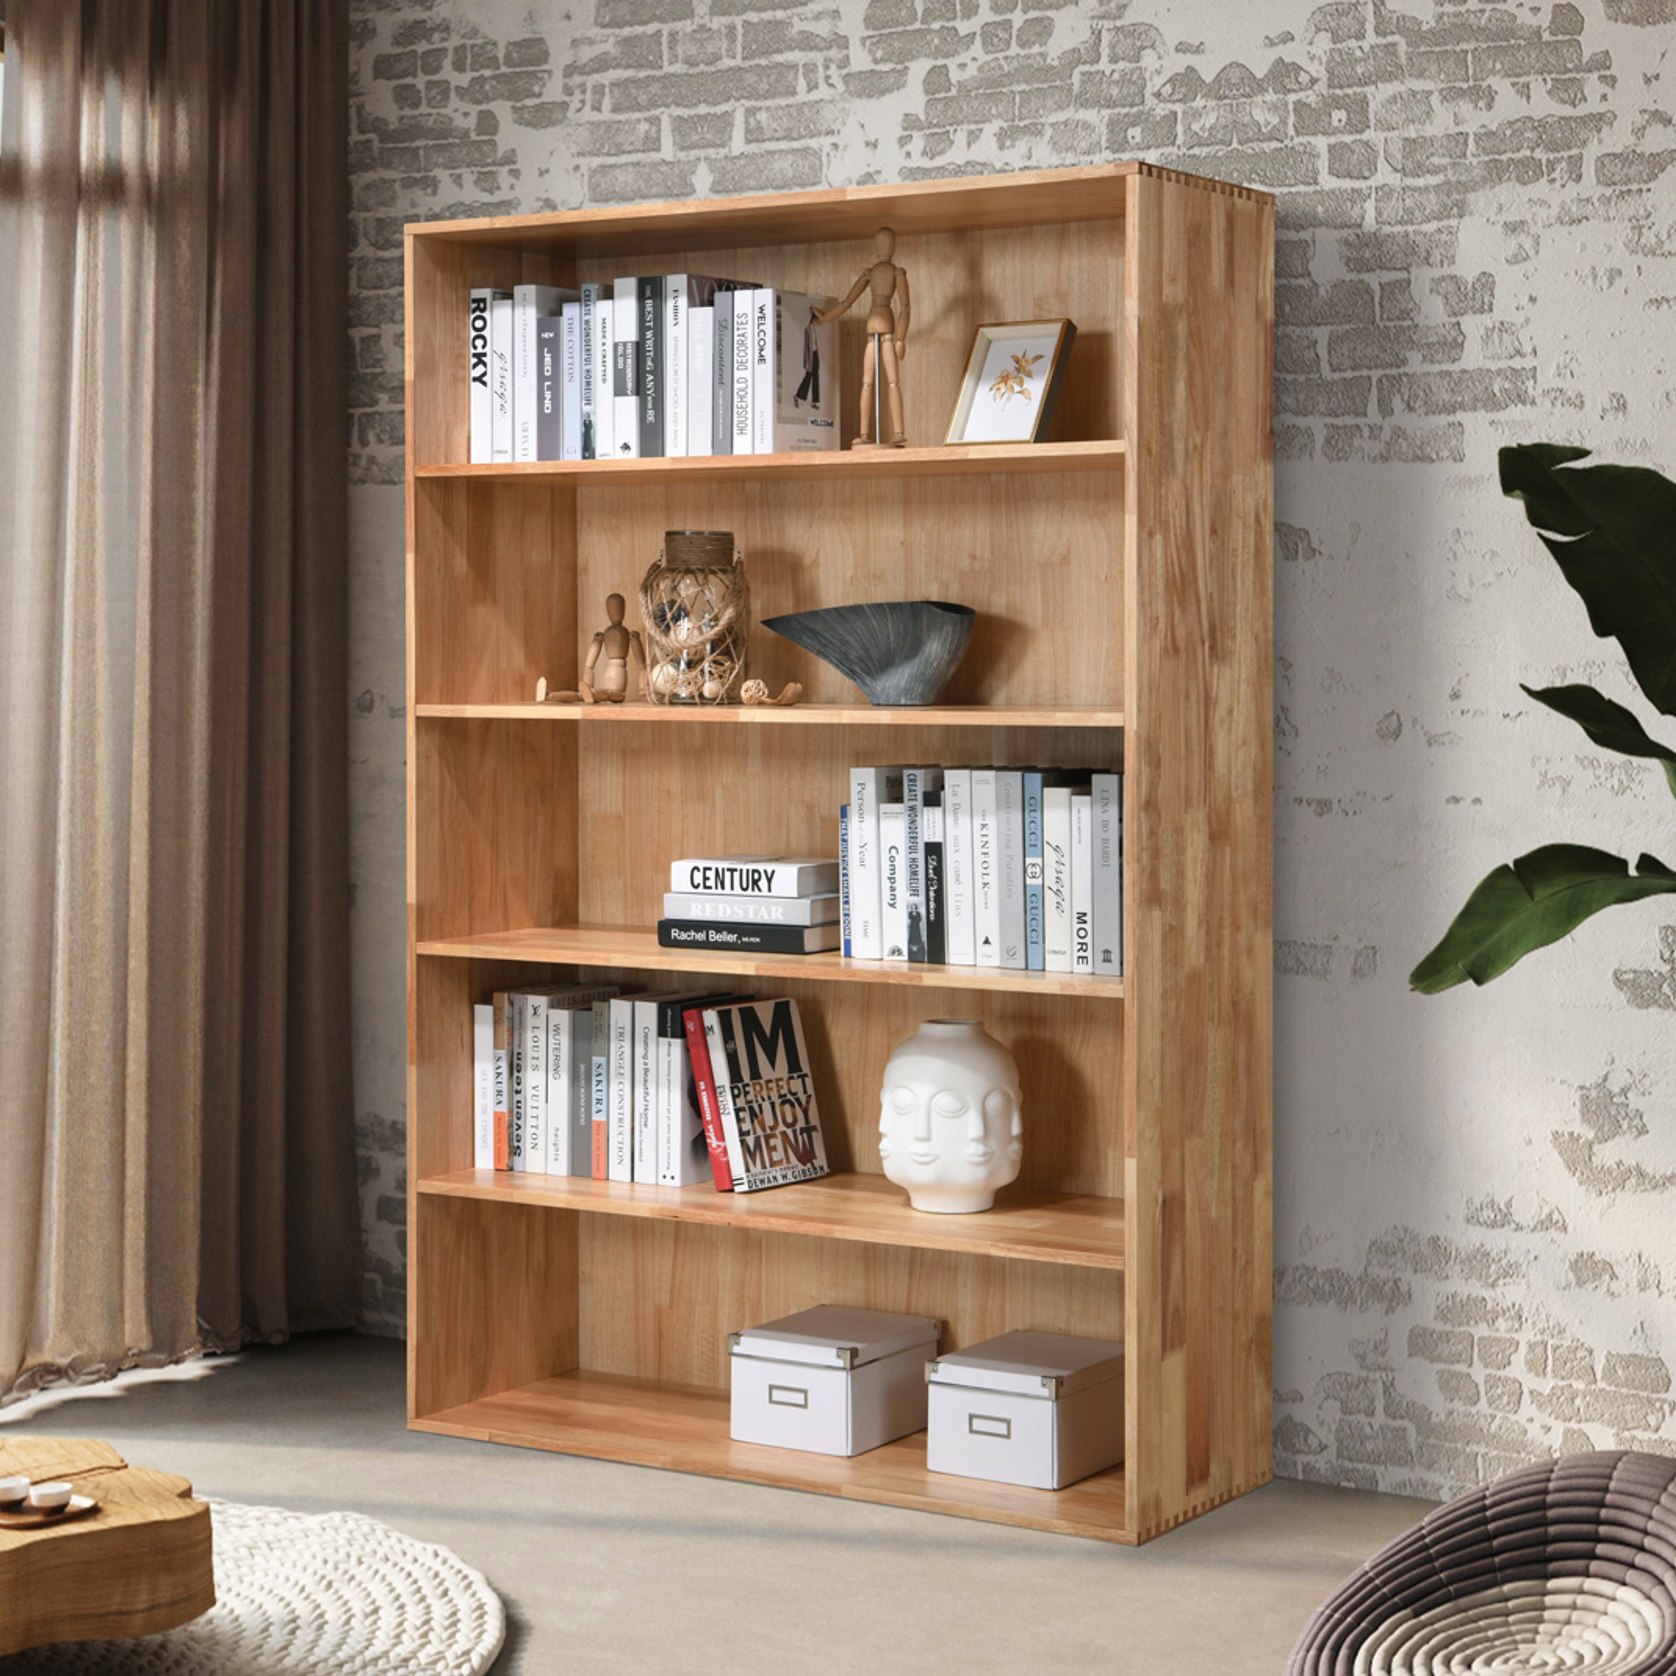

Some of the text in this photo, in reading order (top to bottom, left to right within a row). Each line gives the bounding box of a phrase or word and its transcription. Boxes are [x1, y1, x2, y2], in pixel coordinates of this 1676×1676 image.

[645, 300, 654, 328] BEST
[757, 303, 767, 366] WELCOME
[471, 298, 488, 388] ROCKY
[567, 317, 575, 383] THE COTTON
[583, 289, 593, 406] CREATE WONDERFUL HOMELIFE
[736, 312, 749, 436] HOUSEHOLD DECORATES
[856, 782, 867, 824] Person
[1028, 796, 1038, 848] GUCCI
[857, 842, 868, 869] Year
[907, 773, 920, 898] CREATE WONDERFUL HOMELIFE
[980, 822, 991, 890] KINFOLK
[1101, 838, 1111, 868] BARDI
[690, 866, 776, 893] CENTURY
[887, 845, 899, 910] Company
[671, 928, 707, 942] Rachel
[690, 902, 785, 920] REDSTAR
[1029, 893, 1039, 946] GUCCI
[1076, 911, 1089, 966] MORE
[552, 1023, 561, 1081] WUTERING
[642, 1026, 651, 1060] Creating
[717, 1000, 803, 1085] IM
[495, 1056, 504, 1106] SAKURA
[530, 1026, 541, 1151] LOUIS VUITTON
[594, 1062, 604, 1115] SAKURA
[617, 1025, 626, 1166] TRIANGLE CONSTRUCTION
[642, 1067, 650, 1103] Beautiful
[730, 1073, 809, 1107] PERFECT
[734, 1094, 812, 1137] ENJOY
[552, 1126, 560, 1162] heights
[739, 1125, 819, 1173] MENT
[747, 1174, 778, 1189] DEWAN
